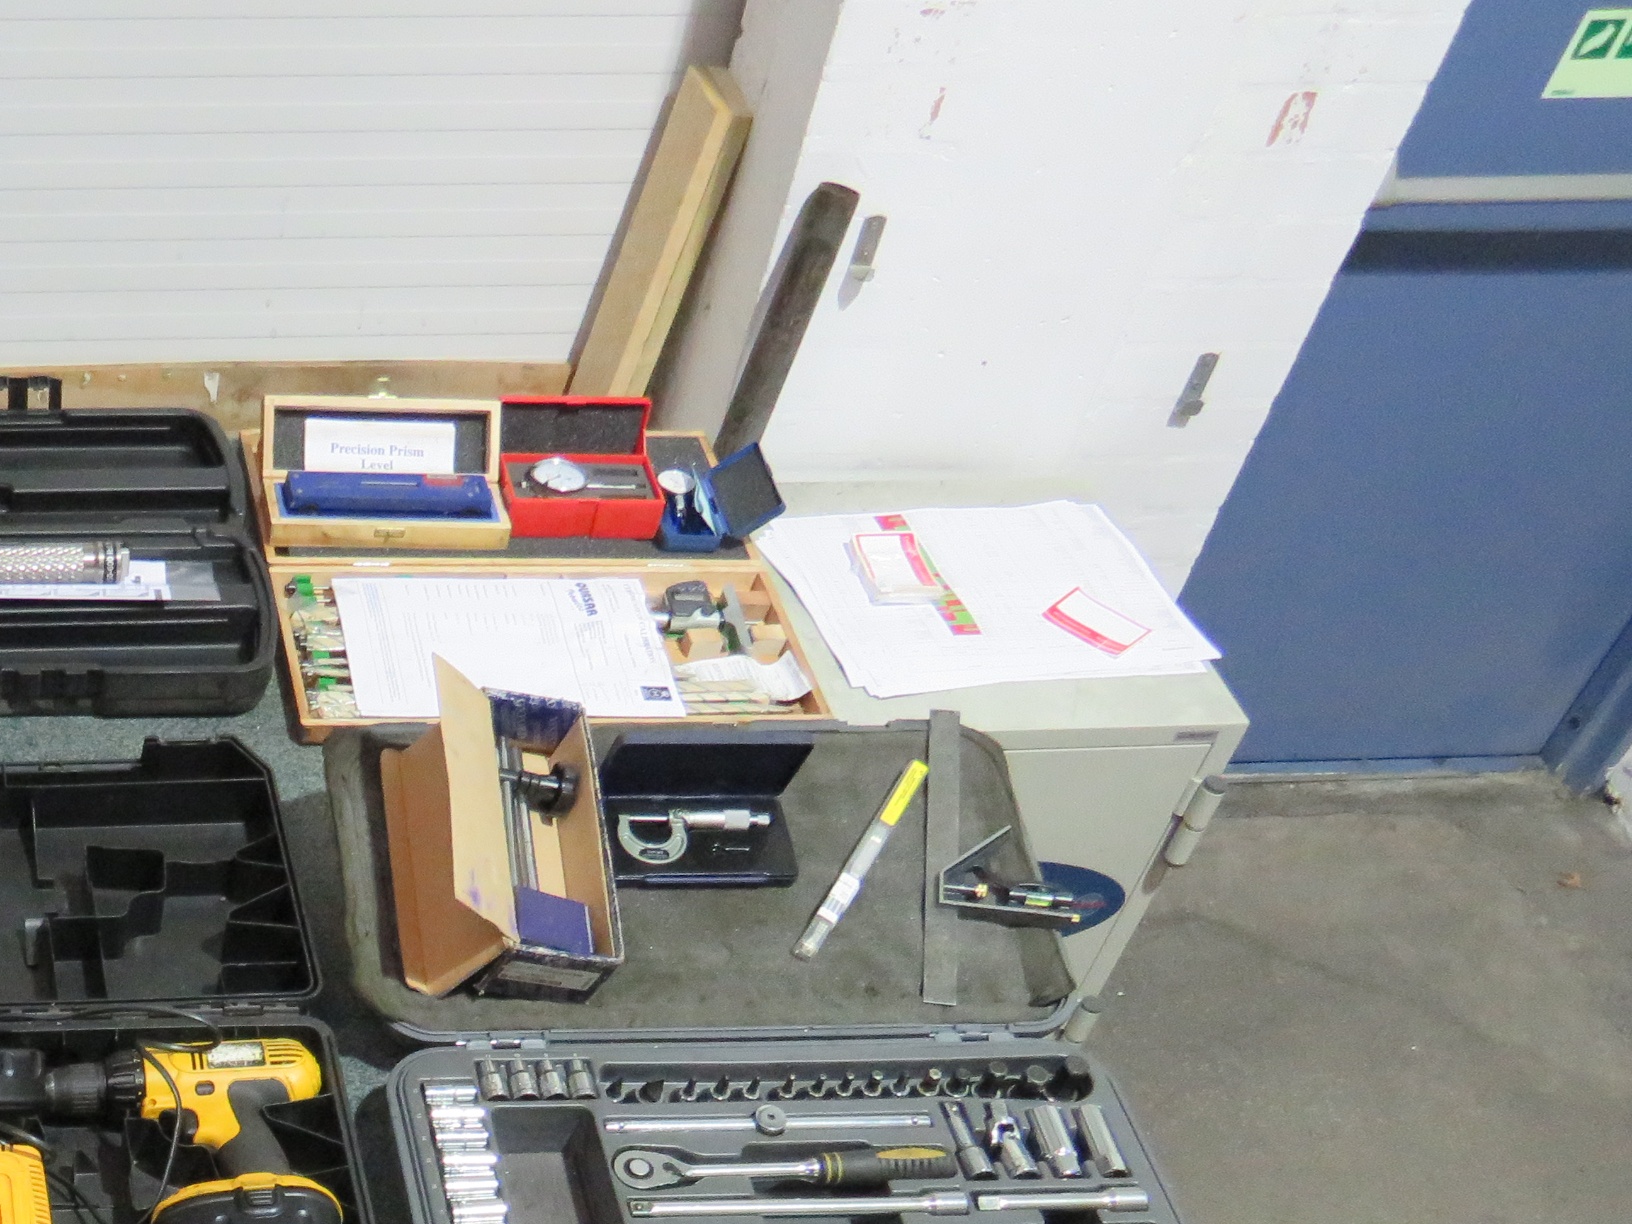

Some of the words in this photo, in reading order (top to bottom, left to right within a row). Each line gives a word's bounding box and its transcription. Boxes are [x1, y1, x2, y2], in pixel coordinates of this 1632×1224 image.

[330, 442, 386, 456] Precision
[389, 444, 425, 458] Prism
[361, 458, 394, 470] Level
